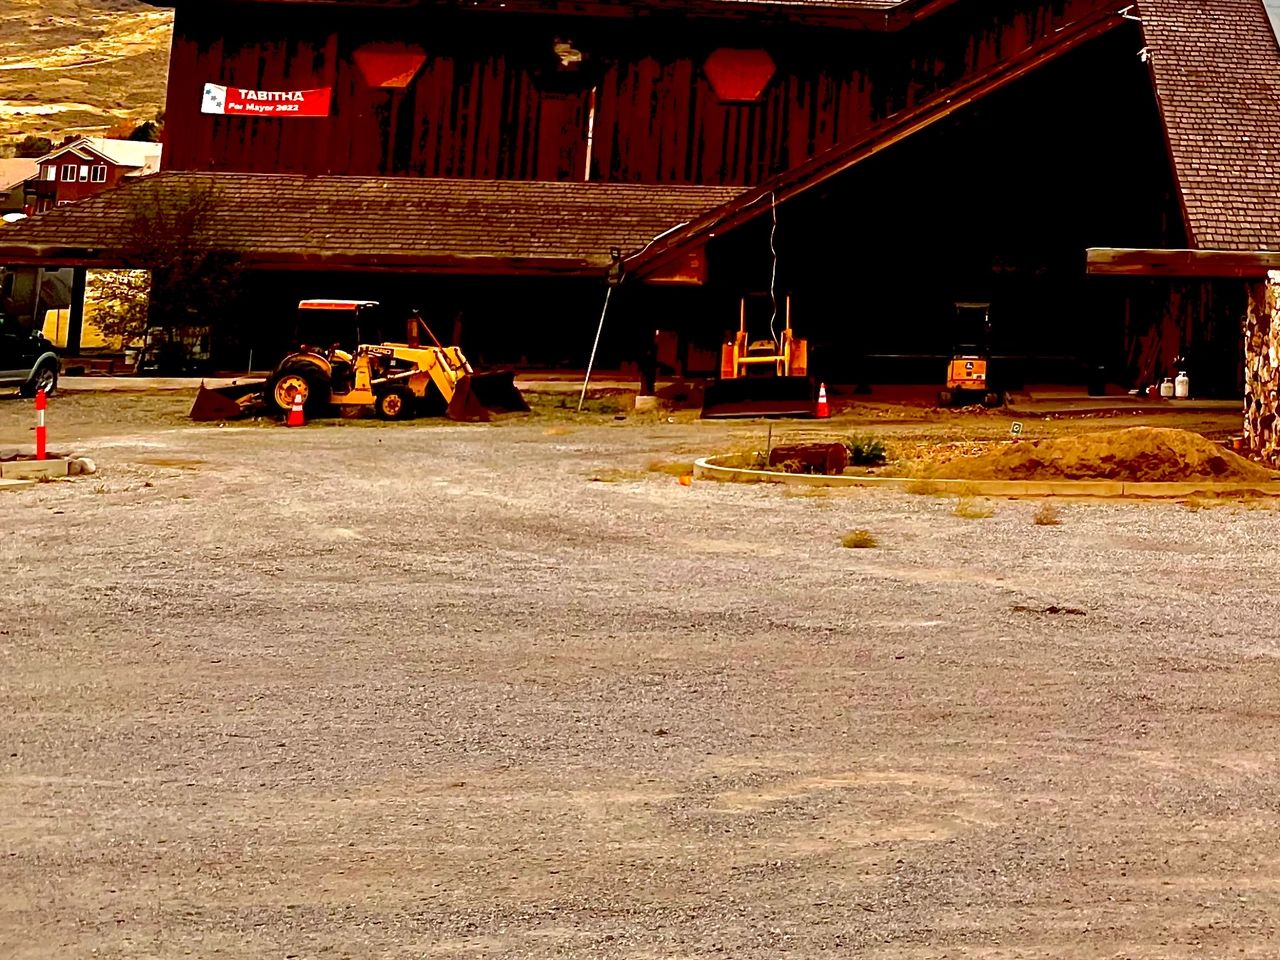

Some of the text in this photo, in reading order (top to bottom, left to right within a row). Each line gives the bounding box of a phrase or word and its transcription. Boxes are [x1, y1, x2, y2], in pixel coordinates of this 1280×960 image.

[238, 89, 304, 101] TABITHA
[246, 103, 274, 112] Mayor
[368, 347, 391, 355] FORD
